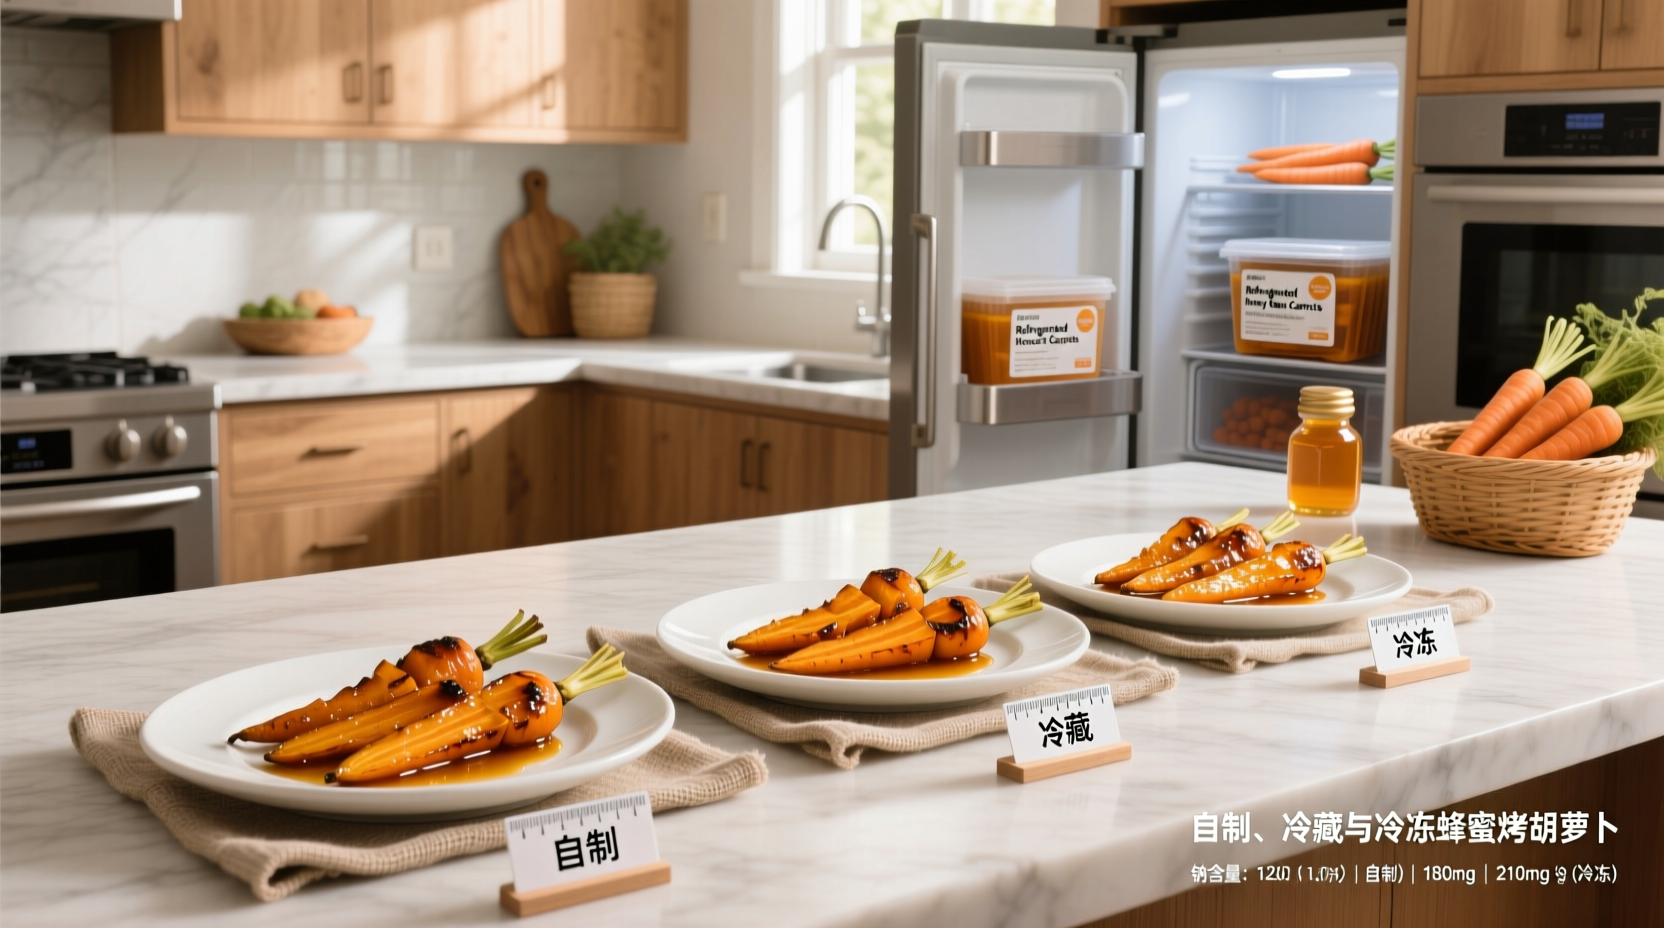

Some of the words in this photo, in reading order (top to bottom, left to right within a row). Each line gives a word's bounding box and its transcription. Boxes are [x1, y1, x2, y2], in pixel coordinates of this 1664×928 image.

[1393, 627, 1438, 659] 冷冻
[1038, 711, 1094, 748] 冷藏
[554, 825, 619, 871] 自制
